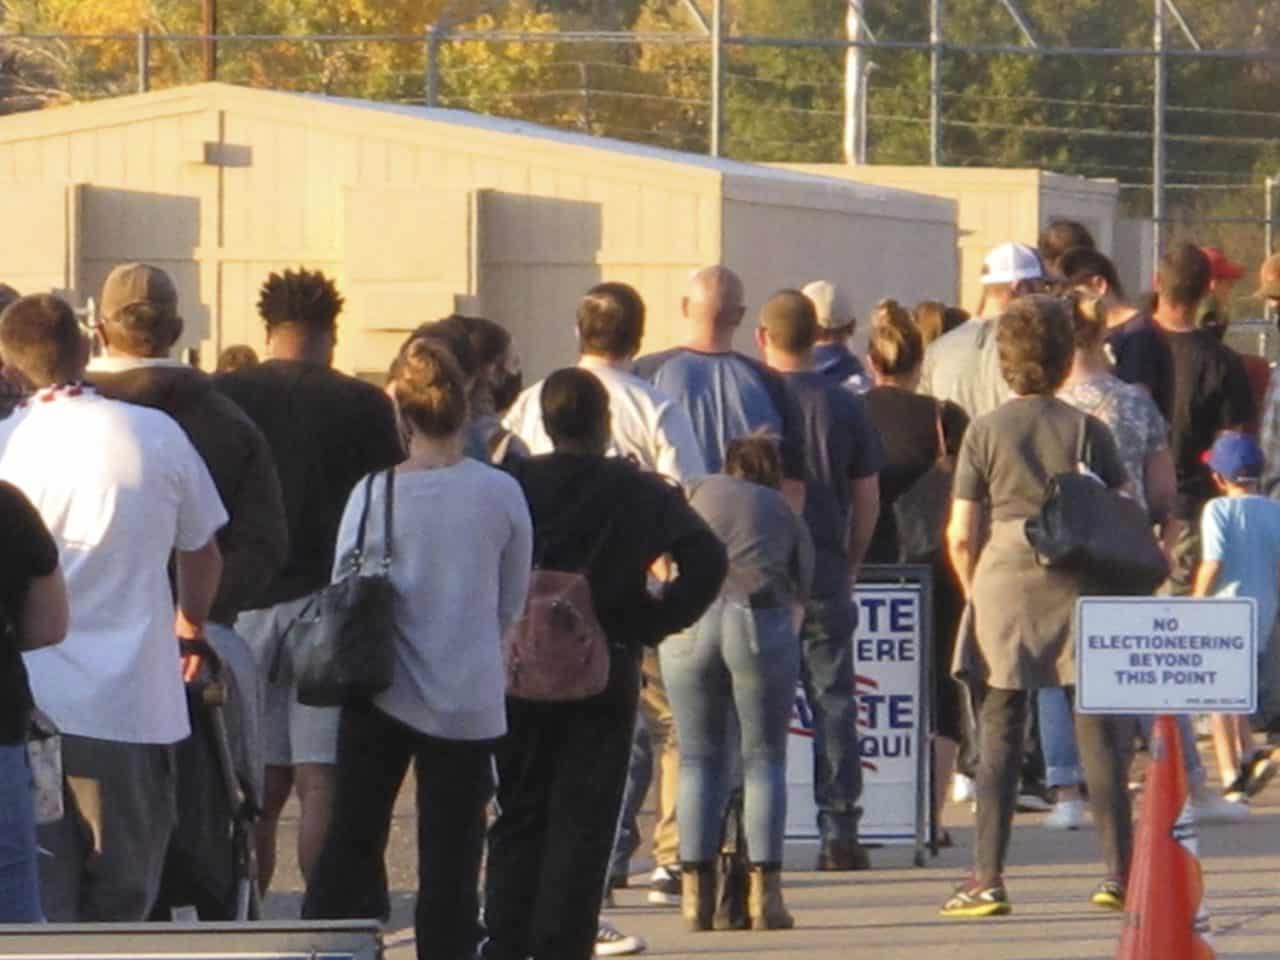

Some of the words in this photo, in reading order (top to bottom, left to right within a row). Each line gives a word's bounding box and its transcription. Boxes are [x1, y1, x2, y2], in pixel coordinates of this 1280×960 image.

[860, 598, 914, 633] TE
[1152, 617, 1179, 632] NO
[857, 639, 915, 662] ERE
[1087, 635, 1245, 651] ELECTIONEERING
[1129, 653, 1204, 667] BEYOND
[1114, 670, 1157, 685] THIS
[1163, 670, 1218, 685] POINT
